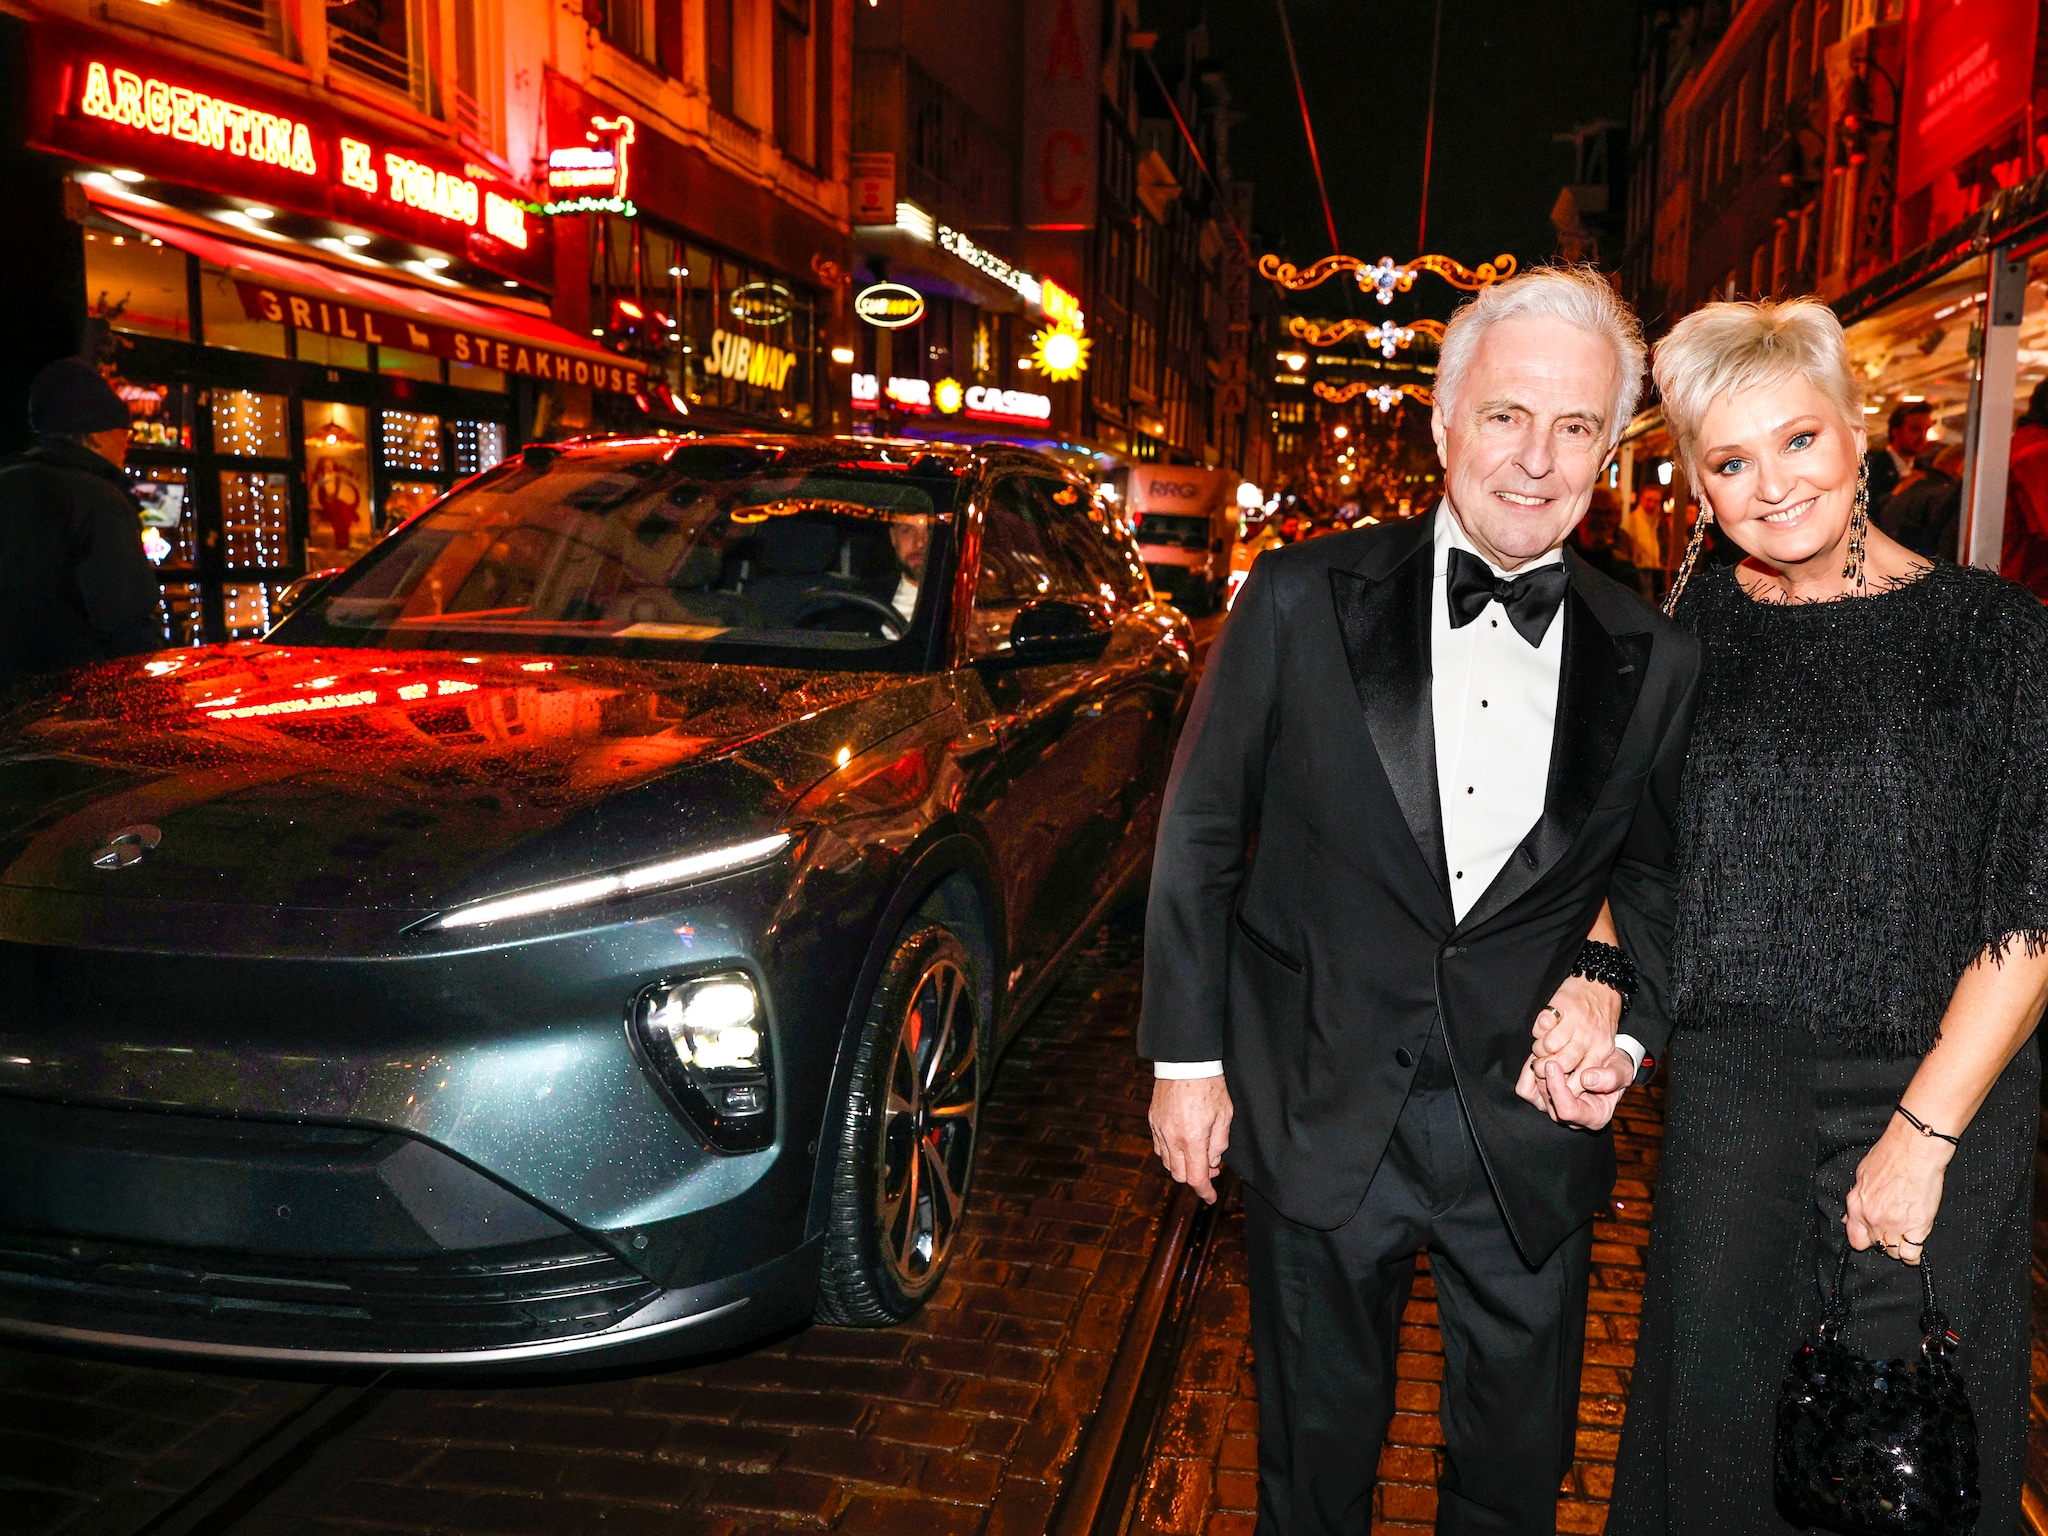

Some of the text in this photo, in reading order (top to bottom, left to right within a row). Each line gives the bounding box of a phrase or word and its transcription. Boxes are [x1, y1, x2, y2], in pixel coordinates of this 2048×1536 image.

[82, 61, 317, 175] ARGENTINA
[340, 137, 378, 193] EL
[257, 289, 639, 396] GRILL STEAKHOUSE
[860, 298, 925, 316] SUBWAY
[703, 328, 797, 392] SUBWAY
